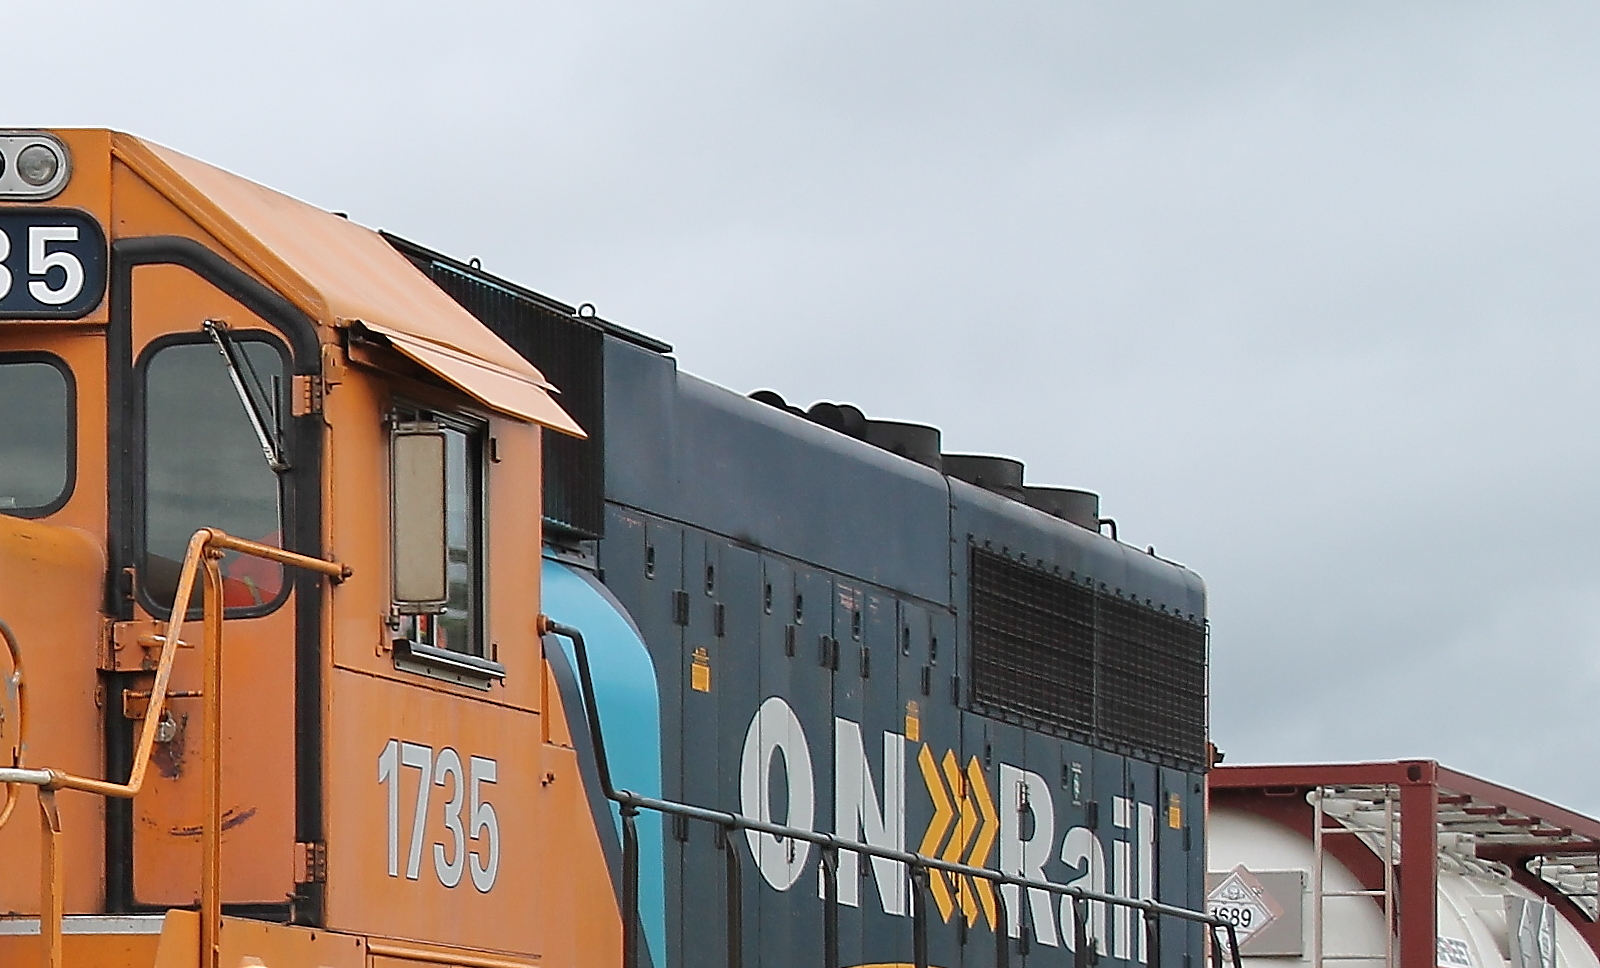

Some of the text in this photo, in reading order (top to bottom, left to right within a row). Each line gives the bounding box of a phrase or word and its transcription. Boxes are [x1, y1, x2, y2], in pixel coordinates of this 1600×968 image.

[378, 738, 500, 893] 1735
[739, 695, 1155, 965] O.N Rail
[1210, 907, 1253, 929] 1689
